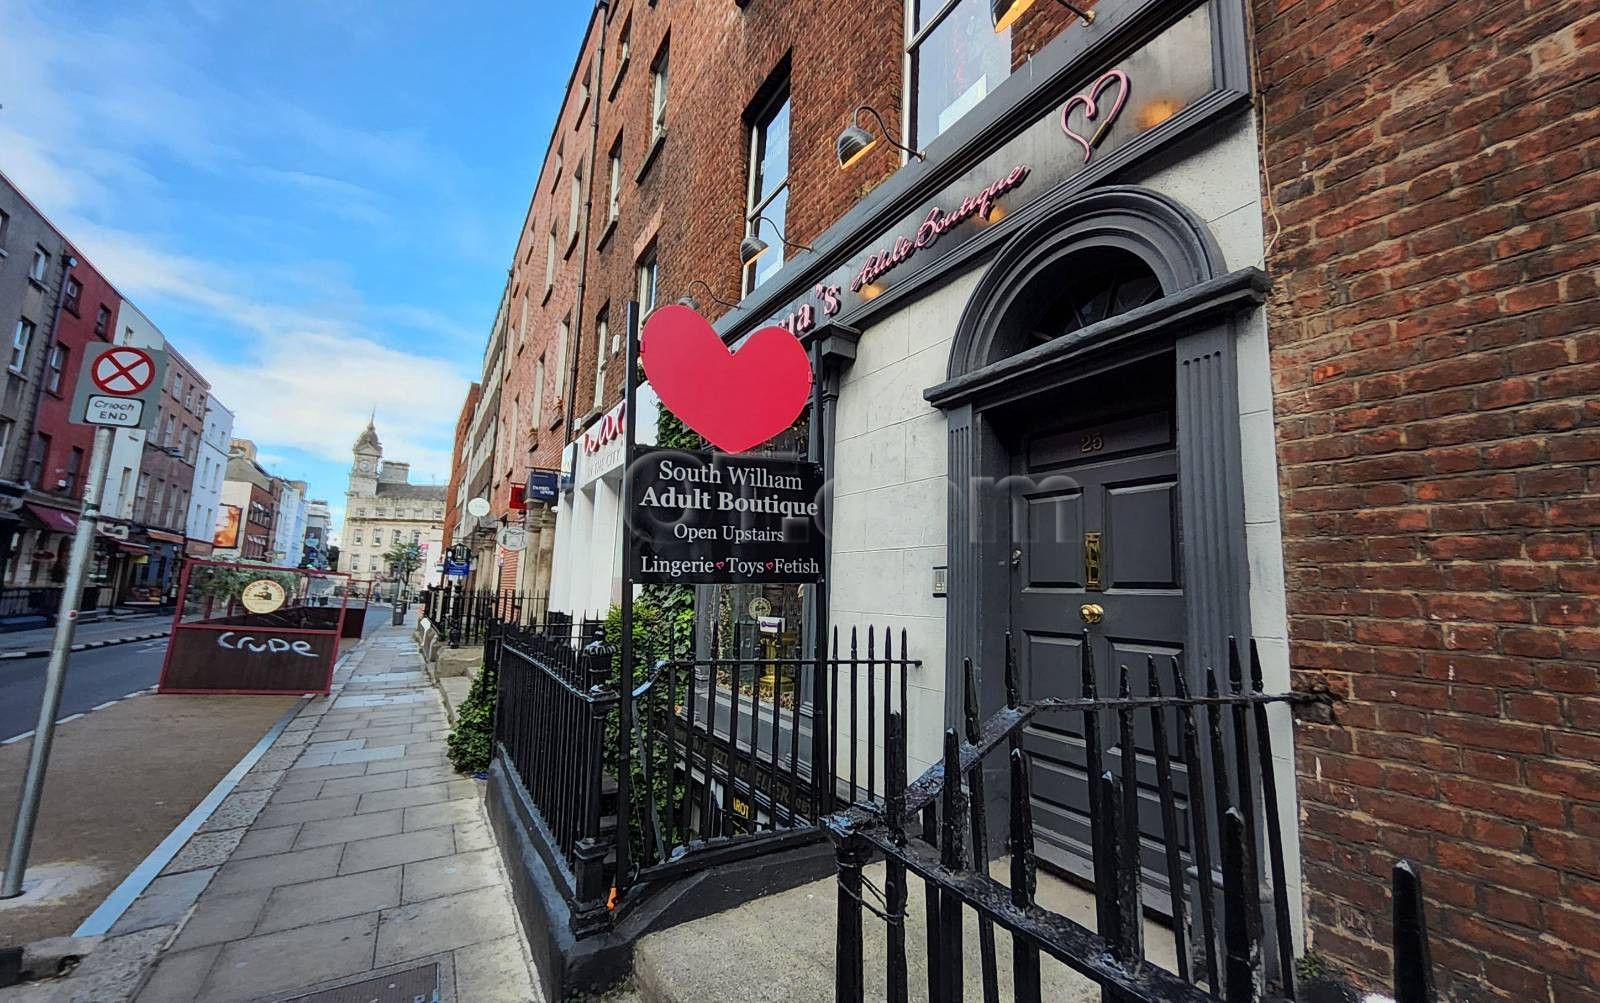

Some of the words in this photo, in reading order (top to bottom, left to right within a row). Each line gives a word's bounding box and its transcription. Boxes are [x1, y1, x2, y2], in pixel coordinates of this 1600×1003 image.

[849, 236, 914, 291] Adult
[914, 165, 1031, 248] Boutique
[99, 411, 128, 421] END
[1081, 433, 1103, 452] 25
[659, 460, 722, 484] South
[727, 466, 803, 490] William
[639, 486, 712, 510] Adult
[717, 491, 818, 518] Boutique
[673, 523, 717, 542] Open
[722, 525, 785, 544] Upstairs
[641, 555, 714, 576] Lingerie
[726, 557, 764, 577] Toys
[773, 558, 820, 574] Fetish
